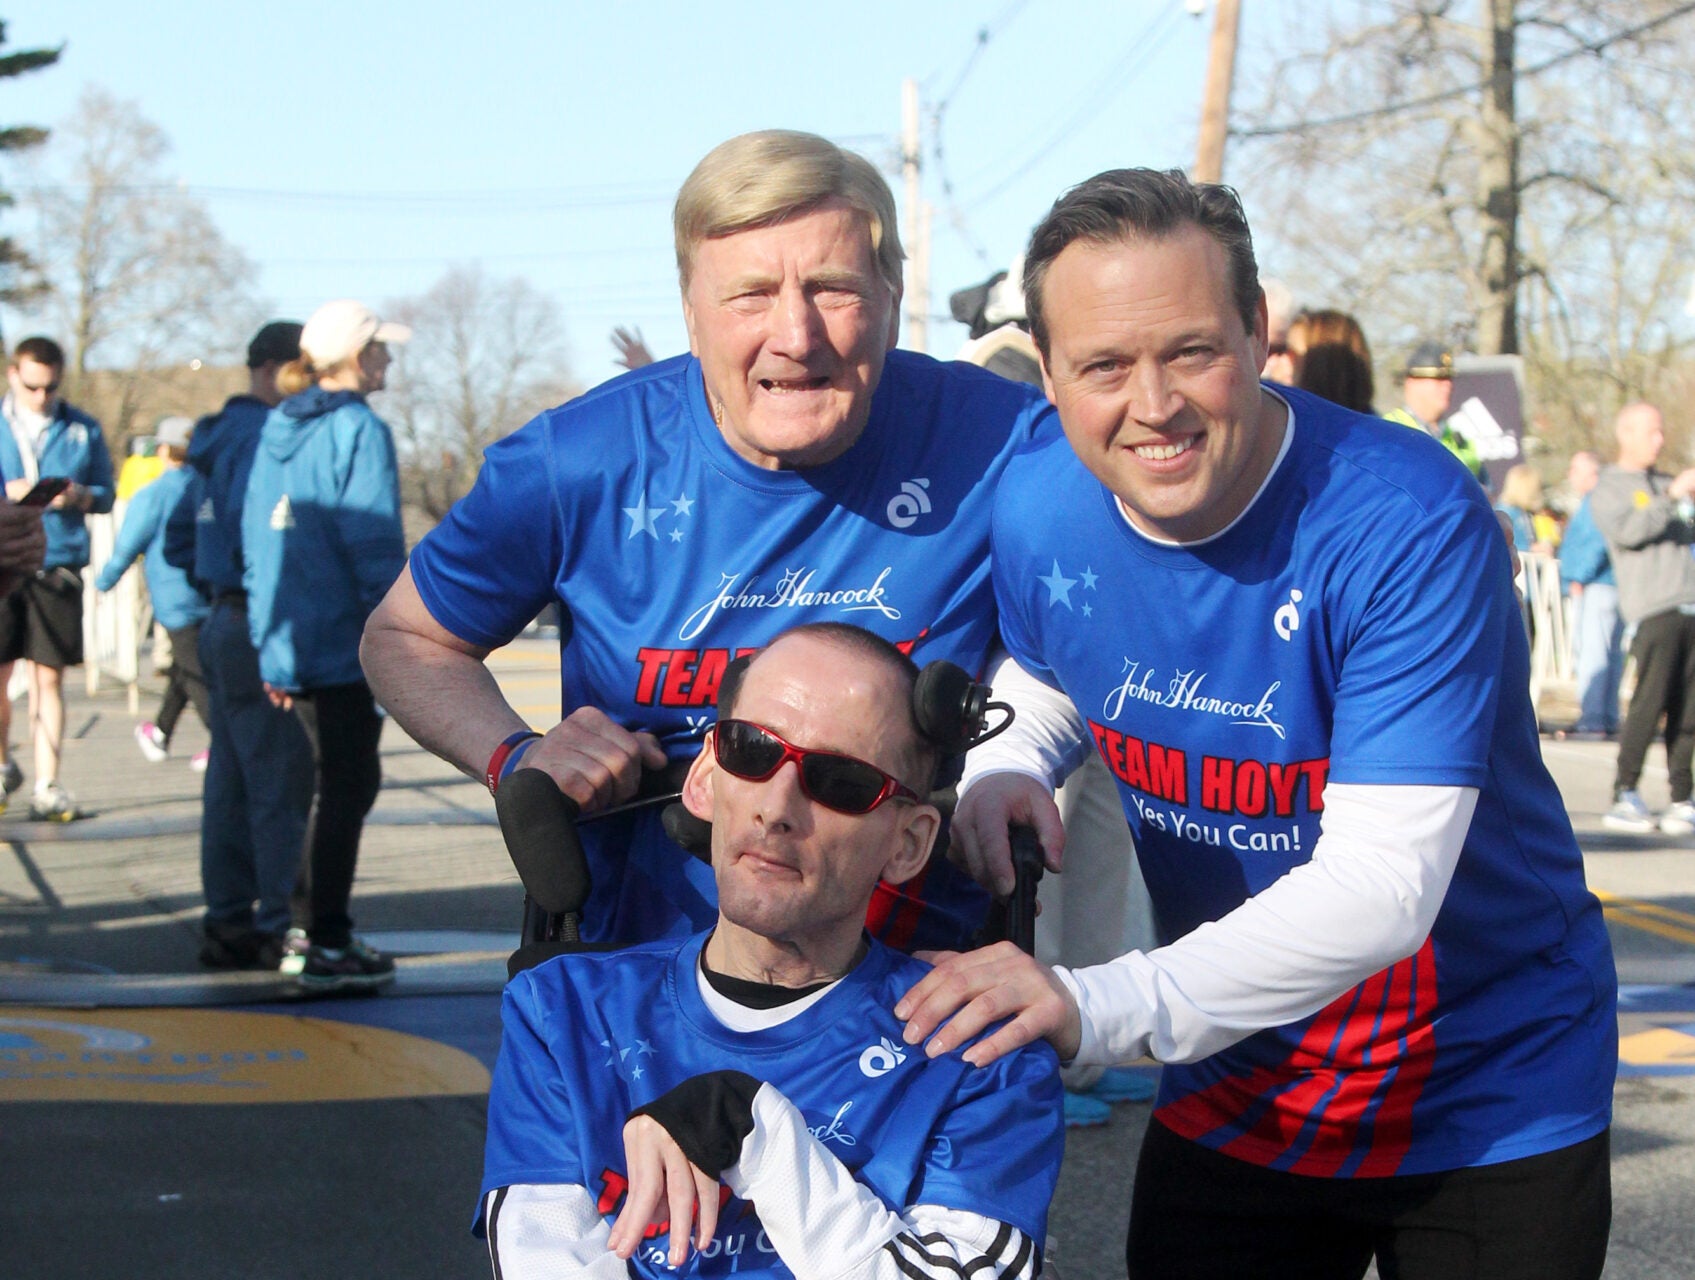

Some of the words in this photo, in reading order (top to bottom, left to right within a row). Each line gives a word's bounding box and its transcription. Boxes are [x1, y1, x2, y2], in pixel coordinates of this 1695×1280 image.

[679, 571, 767, 641] John
[763, 566, 902, 620] Hancock
[634, 647, 758, 709] TEA
[1102, 655, 1164, 721] John
[1160, 668, 1287, 740] Hancock
[1202, 754, 1330, 819] HOYT
[1131, 794, 1166, 832] Yes
[1170, 810, 1221, 847] You
[1227, 823, 1302, 852] Can!
